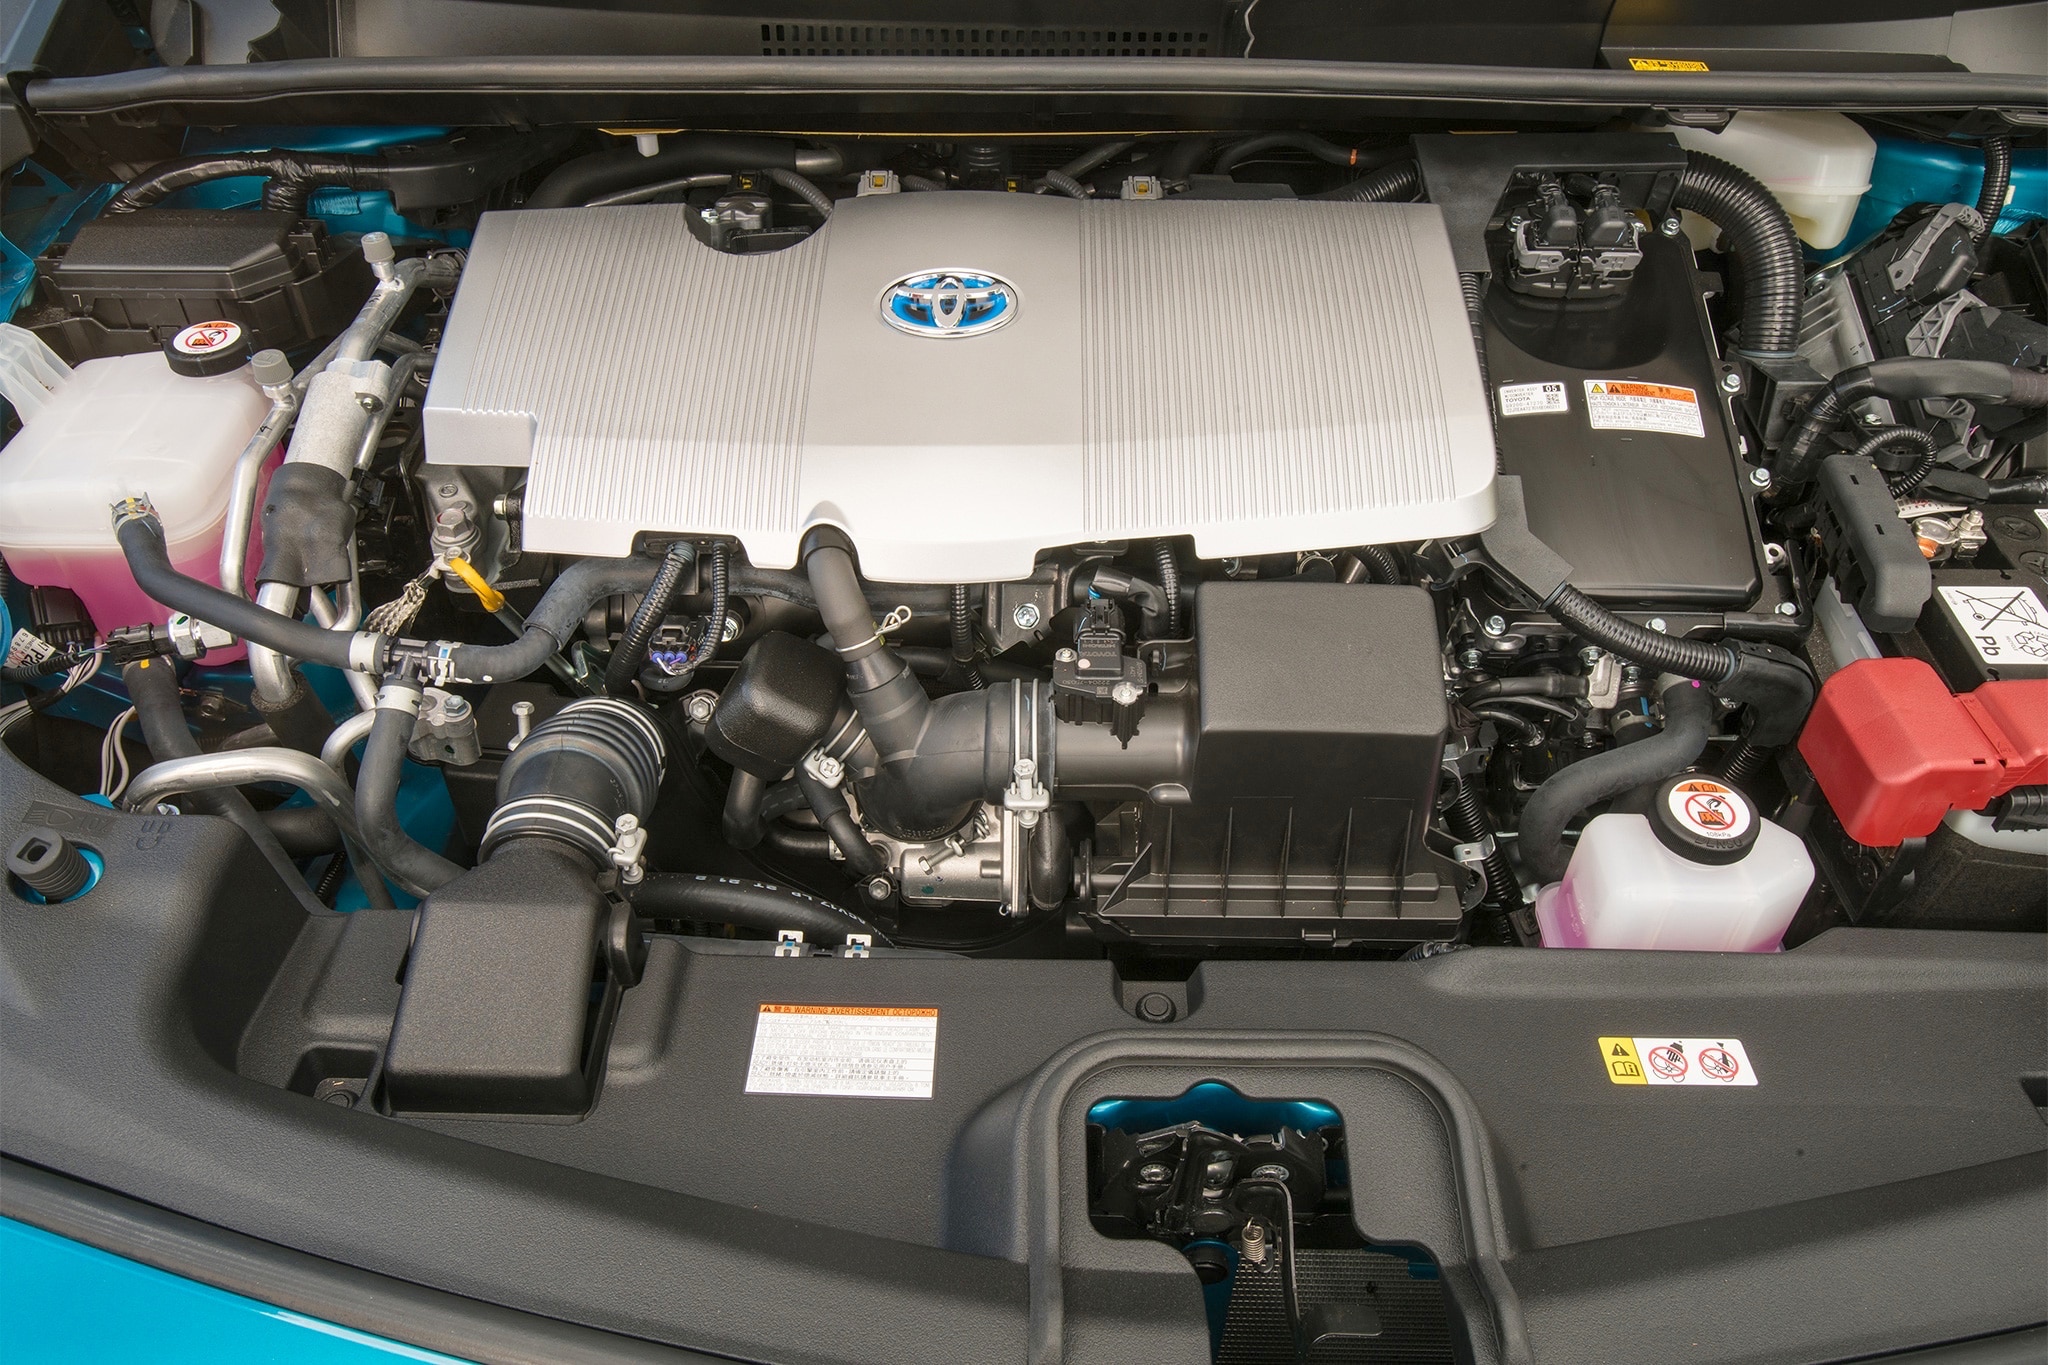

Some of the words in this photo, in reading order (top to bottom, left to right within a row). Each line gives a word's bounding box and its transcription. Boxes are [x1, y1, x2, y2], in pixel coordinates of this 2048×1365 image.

[1975, 635, 2001, 656] Pb
[1694, 837, 1743, 849] DENSO
[795, 1006, 828, 1014] WARNING
[831, 1007, 890, 1016] AVERTISSEMENT
